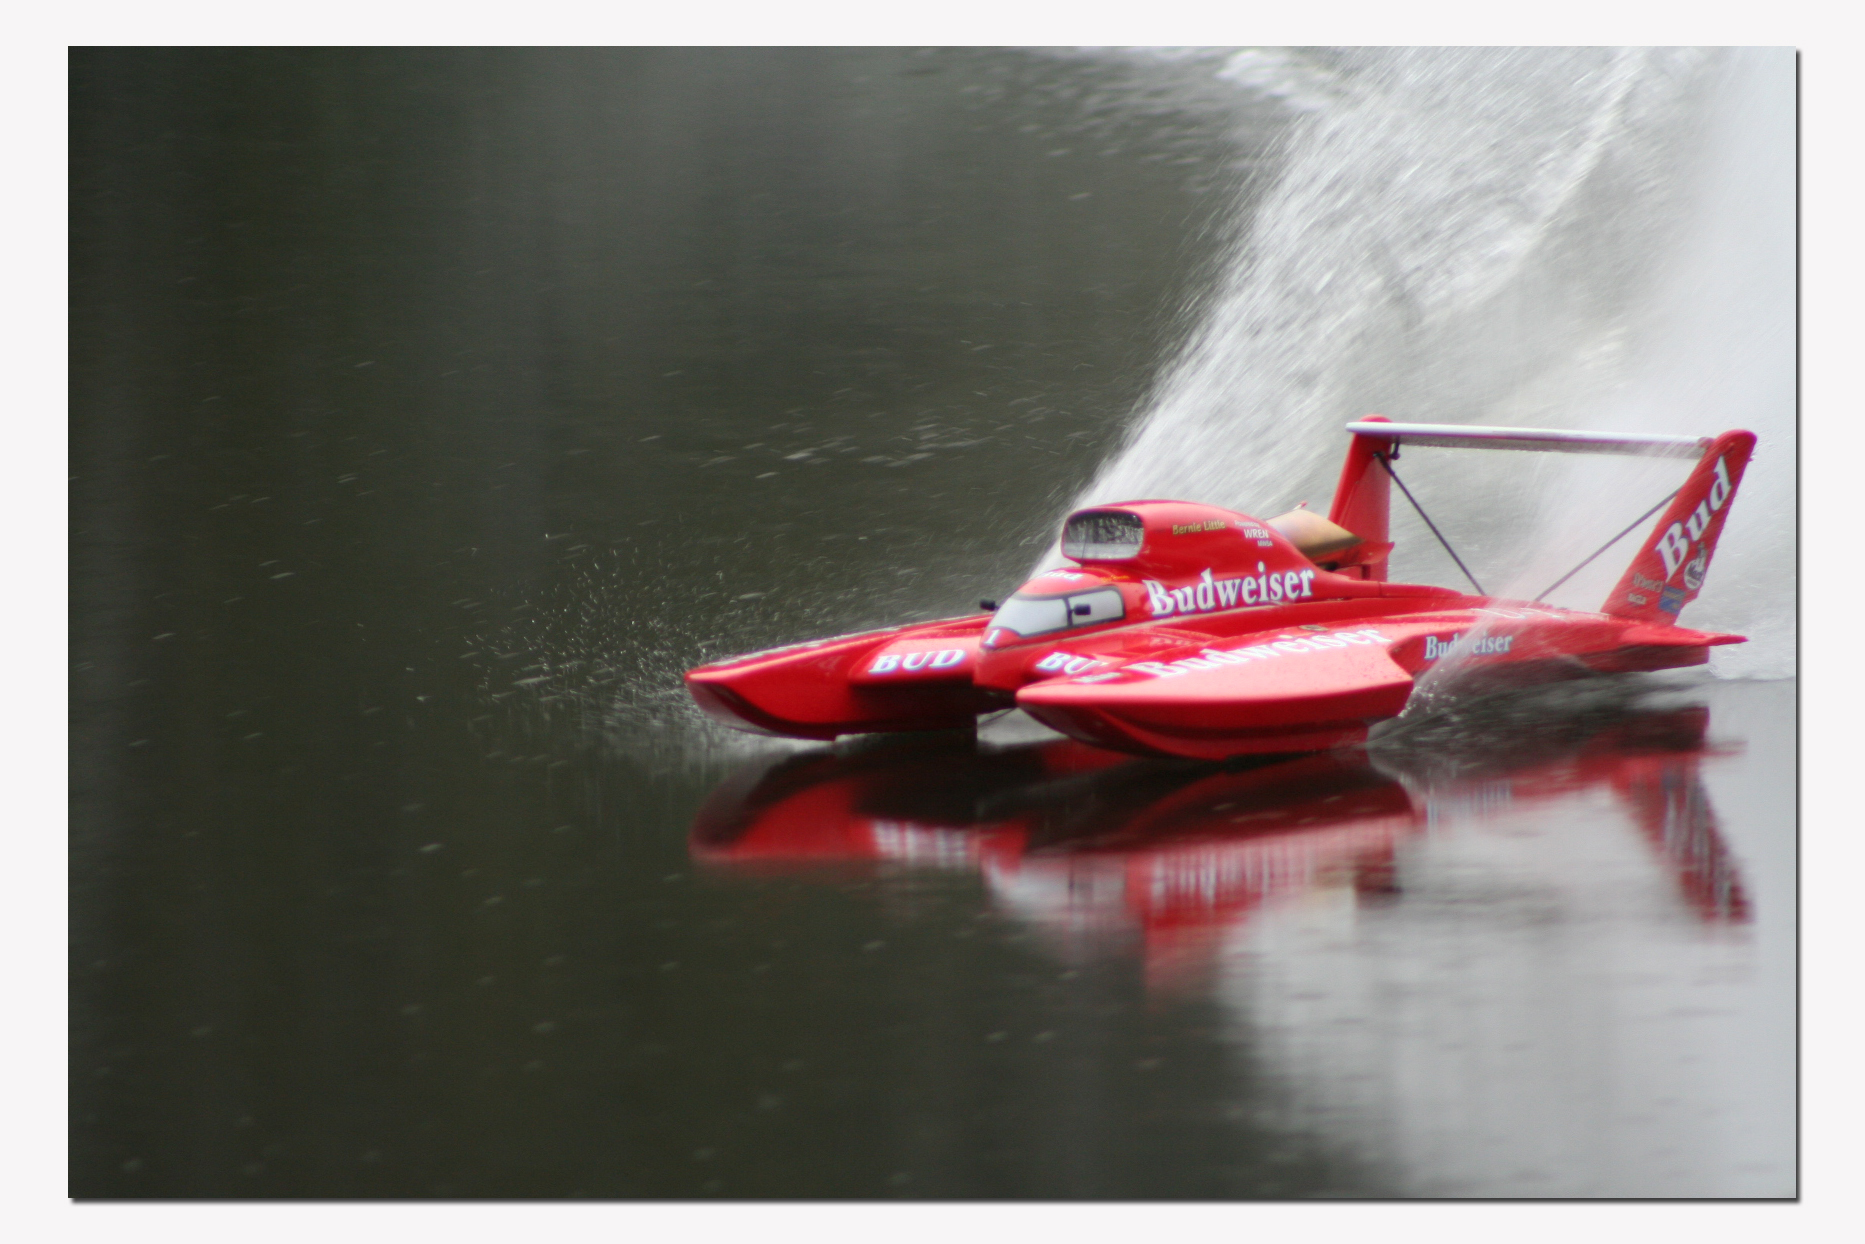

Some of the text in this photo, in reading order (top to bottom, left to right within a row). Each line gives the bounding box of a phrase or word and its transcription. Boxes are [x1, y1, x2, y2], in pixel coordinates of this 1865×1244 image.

[1172, 523, 1202, 535] Bernie
[1203, 520, 1226, 531] Little
[1243, 528, 1269, 539] WREN
[1655, 455, 1732, 584] Bud
[1142, 561, 1315, 617] Budweiser
[1122, 628, 1393, 678] Budweiser
[1424, 631, 1513, 660] Budeiser
[867, 648, 967, 675] BUD
[1035, 651, 1110, 675] BU
